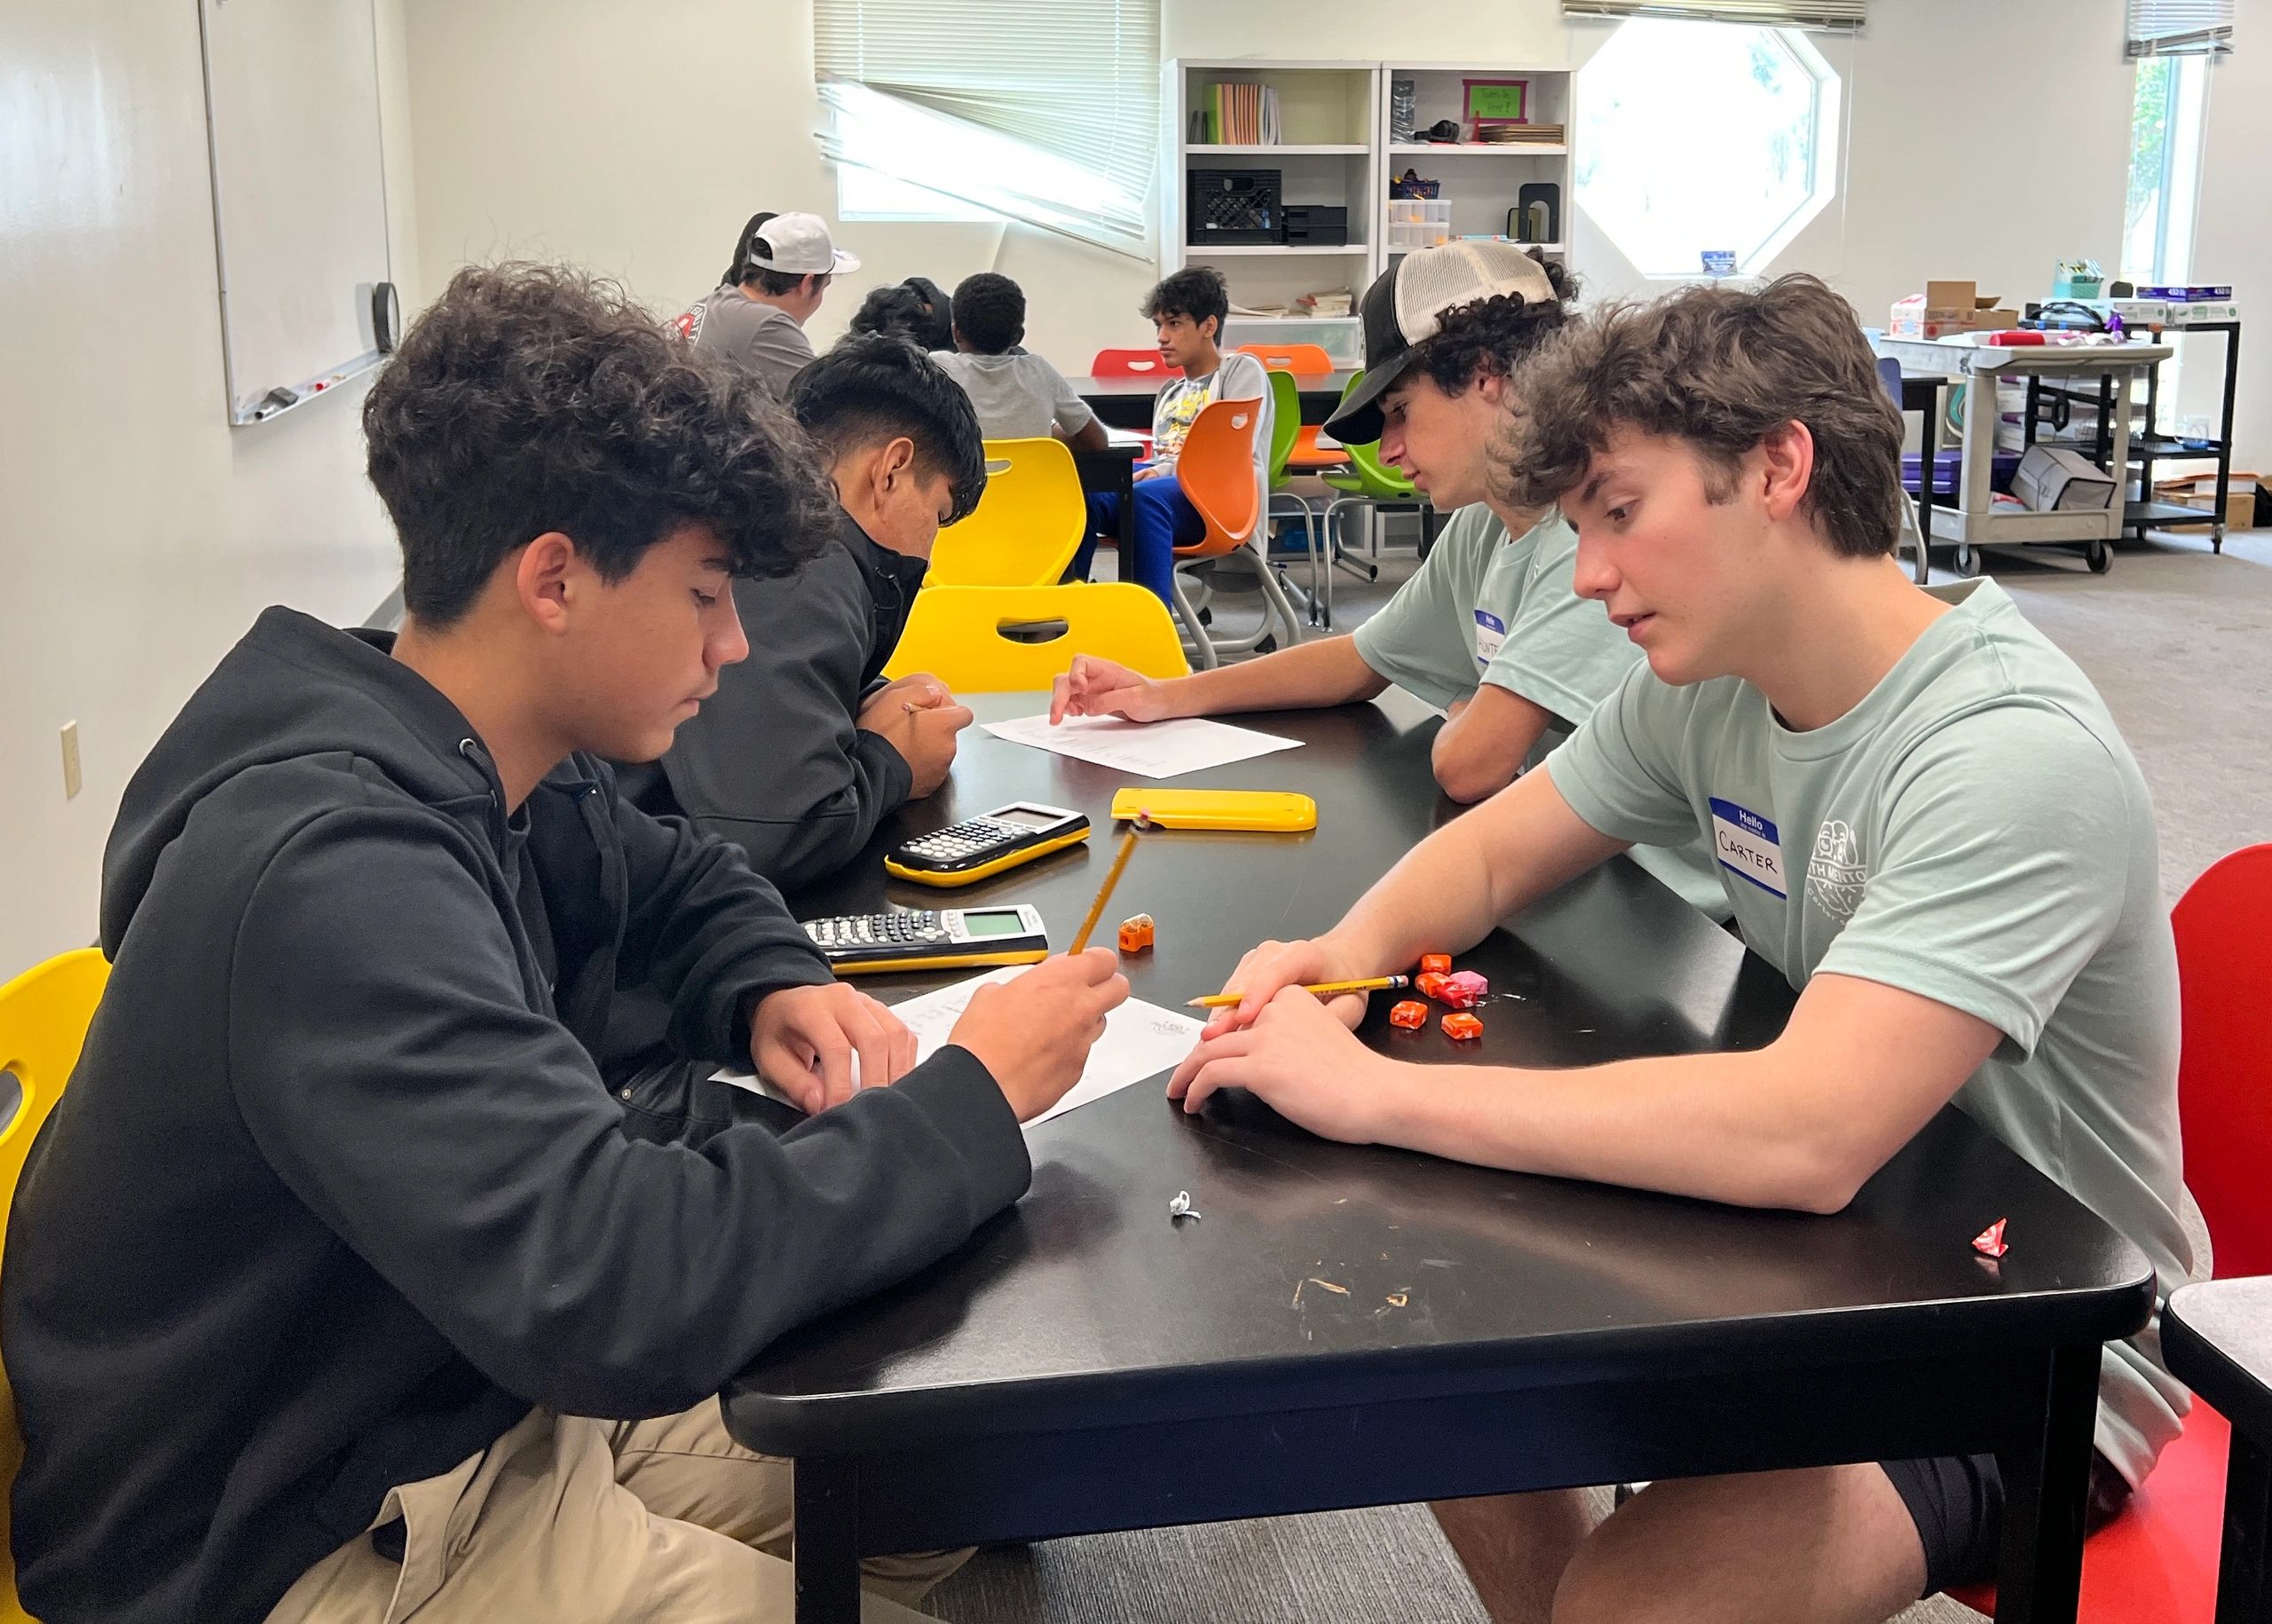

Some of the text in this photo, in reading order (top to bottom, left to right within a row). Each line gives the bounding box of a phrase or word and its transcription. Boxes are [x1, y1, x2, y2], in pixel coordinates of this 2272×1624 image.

[1740, 809, 1763, 831] Hello
[1719, 830, 1778, 874] CARTER
[1827, 865, 1867, 883] MENTO
